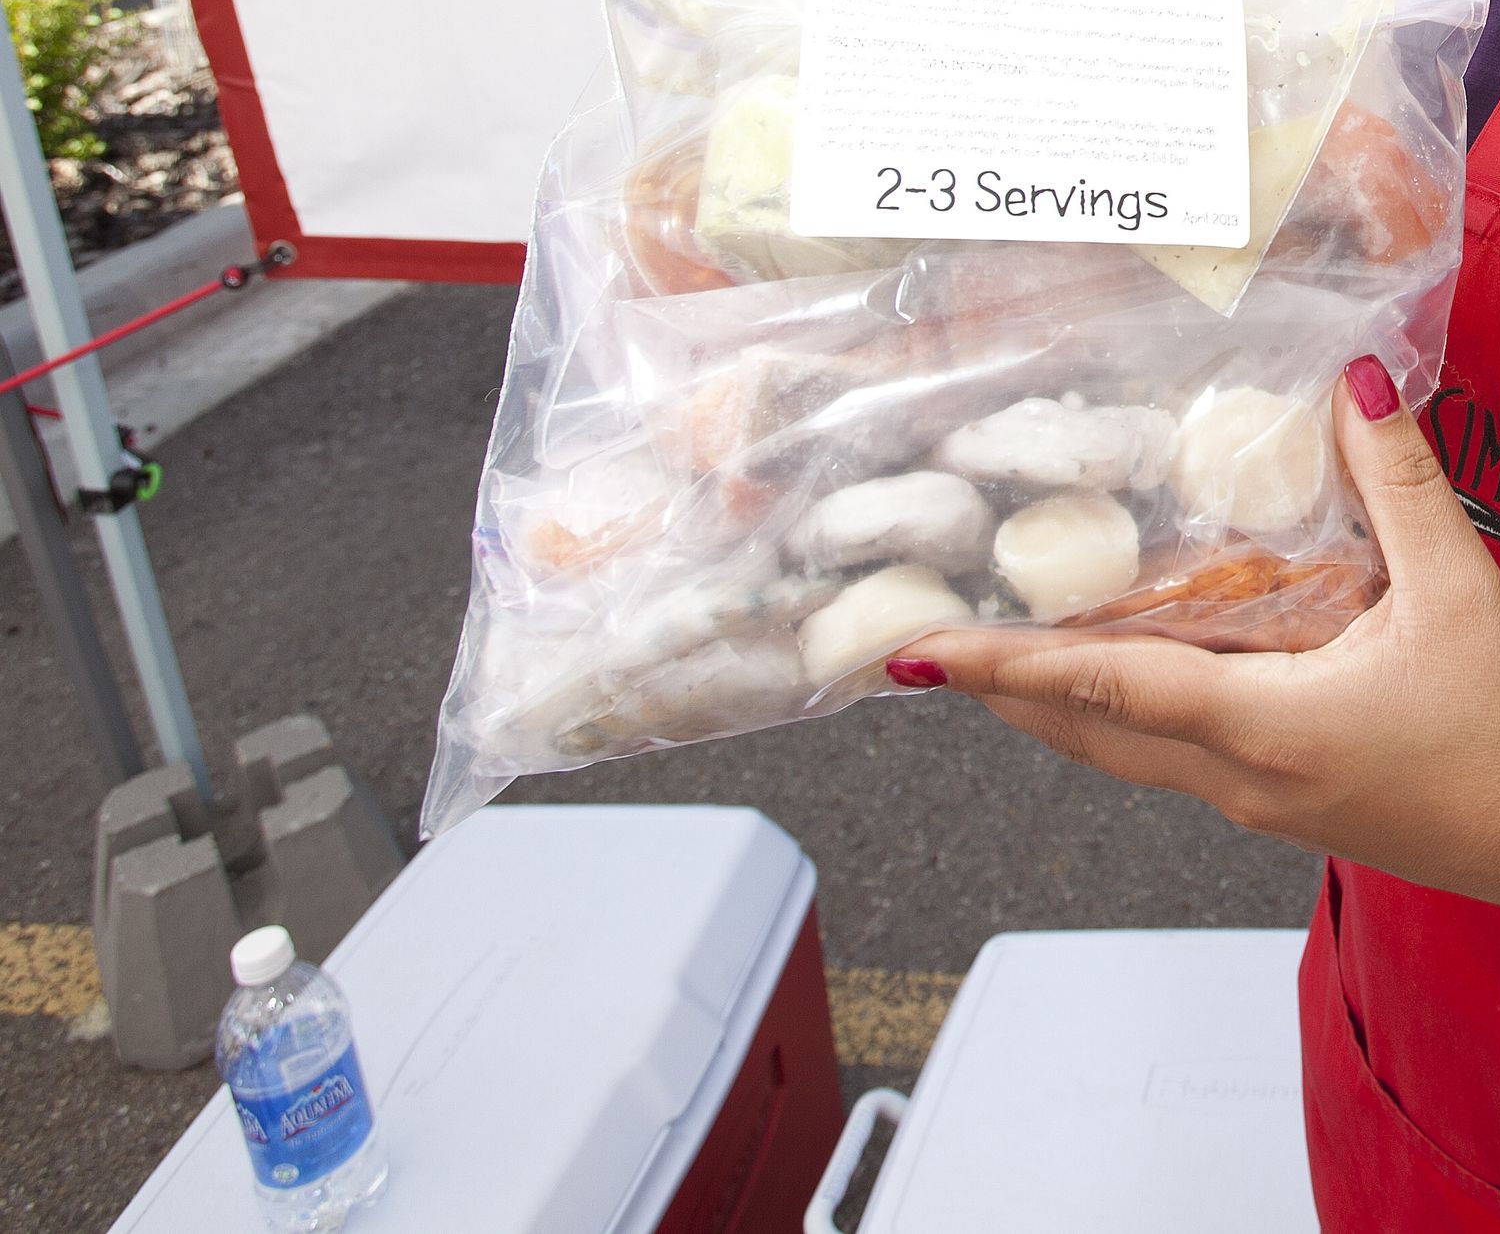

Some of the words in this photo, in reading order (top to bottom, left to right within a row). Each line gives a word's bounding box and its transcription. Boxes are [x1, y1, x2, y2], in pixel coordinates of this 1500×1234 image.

[876, 167, 957, 212] 2-3
[975, 170, 1169, 231] Servings
[1183, 211, 1210, 228] April
[1212, 213, 1239, 228] 2013
